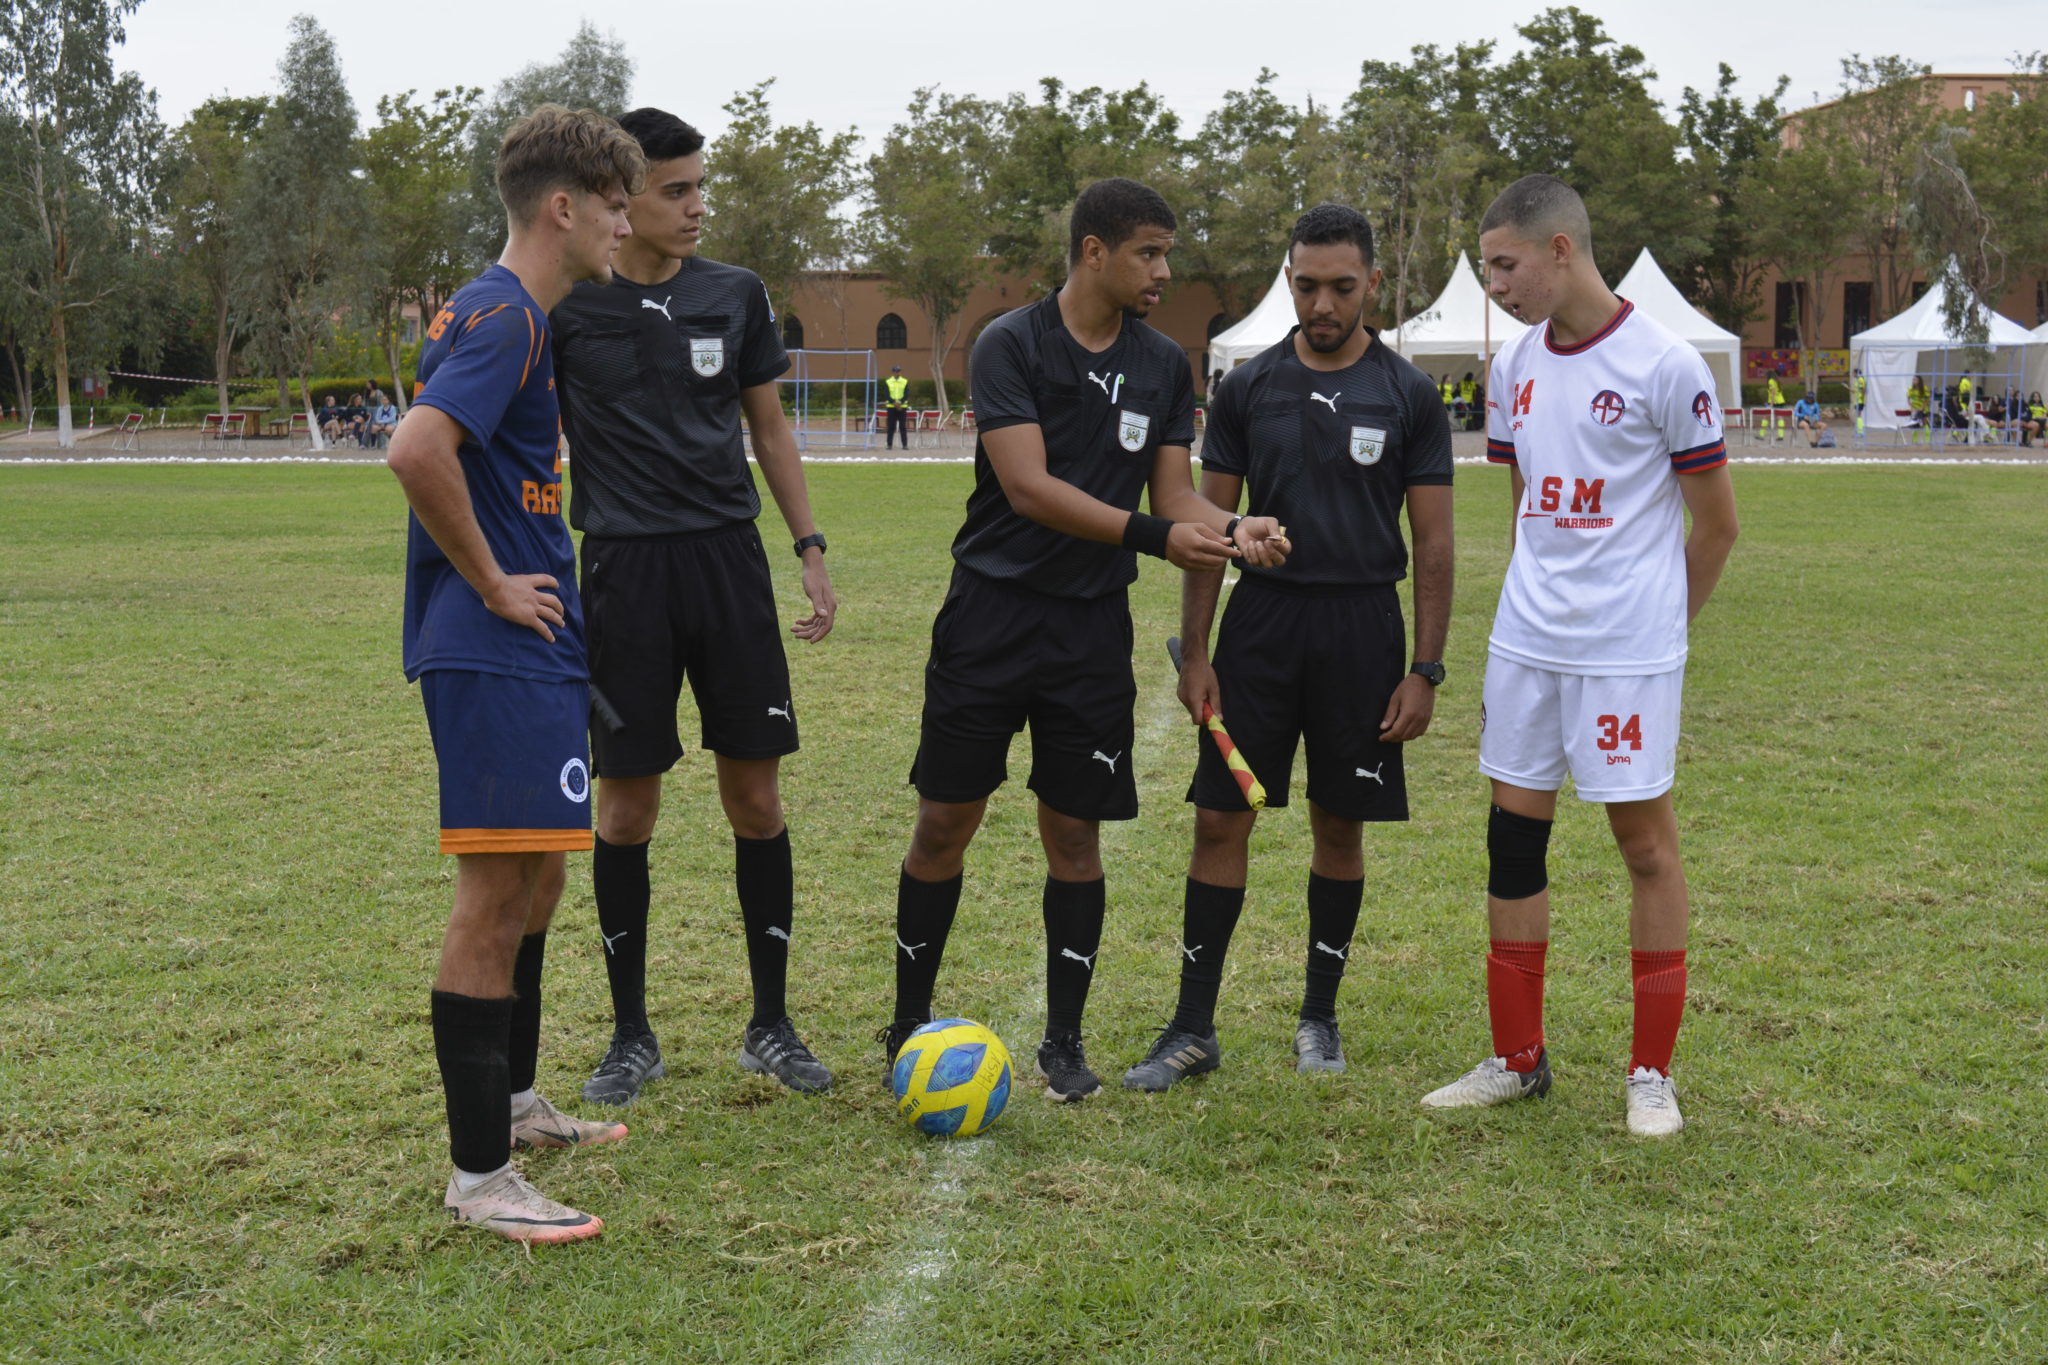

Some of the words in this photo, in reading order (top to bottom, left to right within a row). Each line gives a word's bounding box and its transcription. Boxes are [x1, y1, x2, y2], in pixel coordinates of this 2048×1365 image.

[522, 480, 563, 515] RA
[1528, 475, 1605, 513] SM
[1554, 517, 1614, 529] WARRIORS
[1596, 714, 1642, 751] 34
